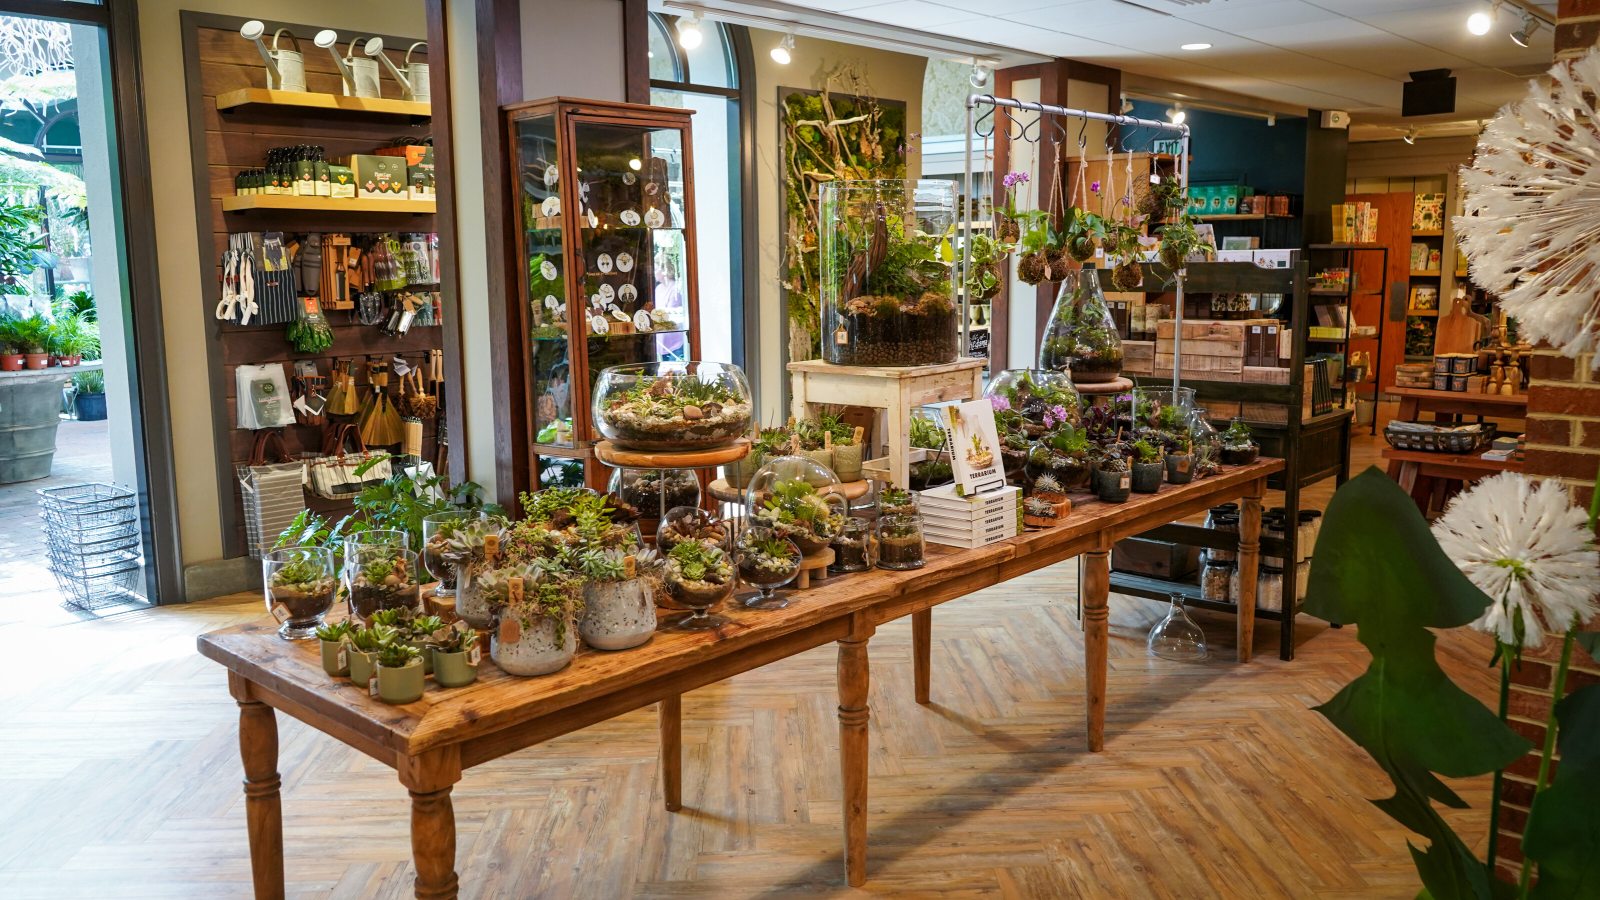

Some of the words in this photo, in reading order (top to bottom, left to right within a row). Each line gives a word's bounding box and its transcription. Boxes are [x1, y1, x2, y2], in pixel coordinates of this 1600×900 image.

[1159, 141, 1179, 154] EXIT
[947, 428, 956, 460] TERRARIUM
[970, 468, 996, 479] TERRARIUM
[985, 497, 1004, 505] TERRARIUM
[985, 506, 1004, 514] TERRARIUM
[985, 516, 1004, 524] TERRARIUM
[985, 524, 1004, 533] TERRARIUM
[985, 534, 1004, 542] TERRARIUM
